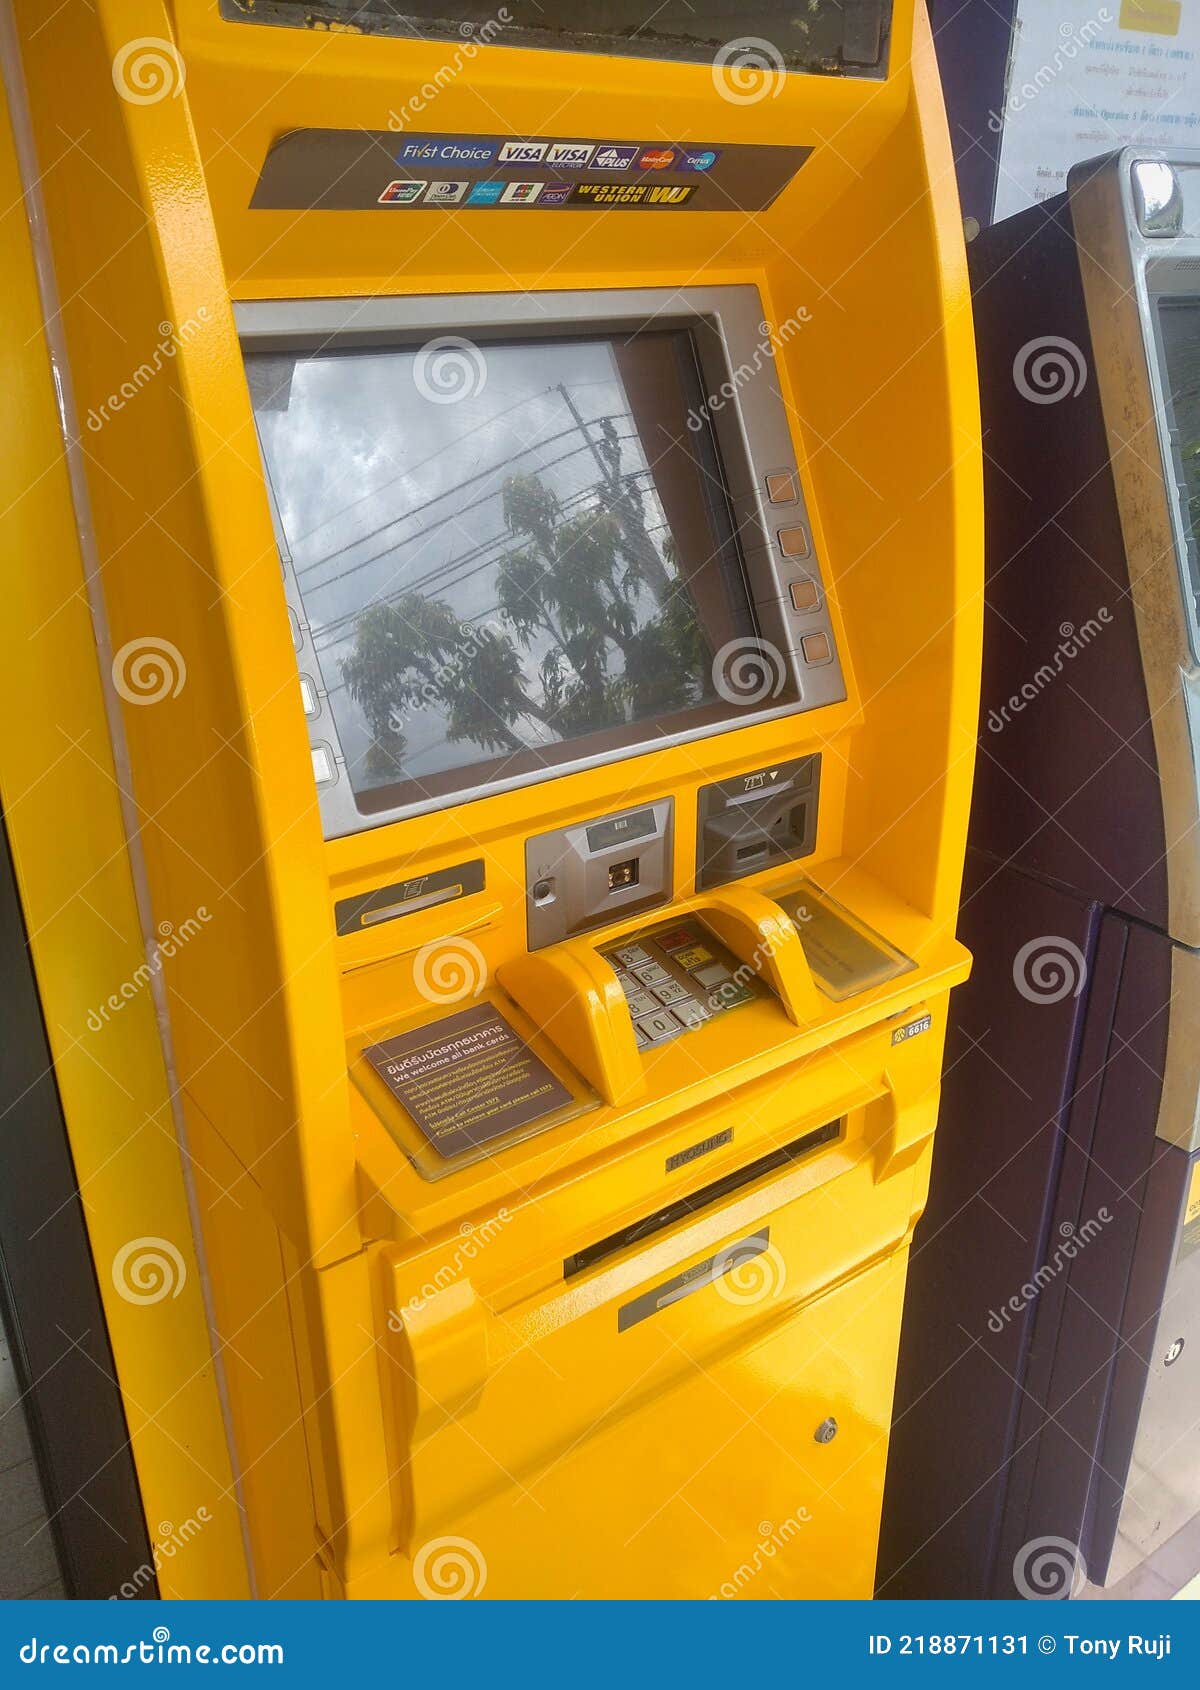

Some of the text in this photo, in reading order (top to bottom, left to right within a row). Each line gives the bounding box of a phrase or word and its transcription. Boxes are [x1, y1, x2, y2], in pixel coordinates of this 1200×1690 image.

[440, 146, 492, 160] Choice
[505, 147, 541, 160] VISA
[553, 150, 588, 162] VISA
[602, 157, 630, 168] PLUS
[578, 185, 646, 194] WESTERN
[650, 186, 692, 203] WU
[594, 194, 643, 203] UNION
[622, 952, 633, 963] 3
[640, 971, 653, 981] 6
[660, 990, 671, 1000] 9
[628, 1003, 639, 1013] 8
[653, 1019, 666, 1031] 0
[908, 1020, 930, 1037] 6616
[386, 1023, 504, 1076] ยินดีรับบัตรทุกธนาคาร
[393, 1032, 510, 1083] We welcome all bank cards
